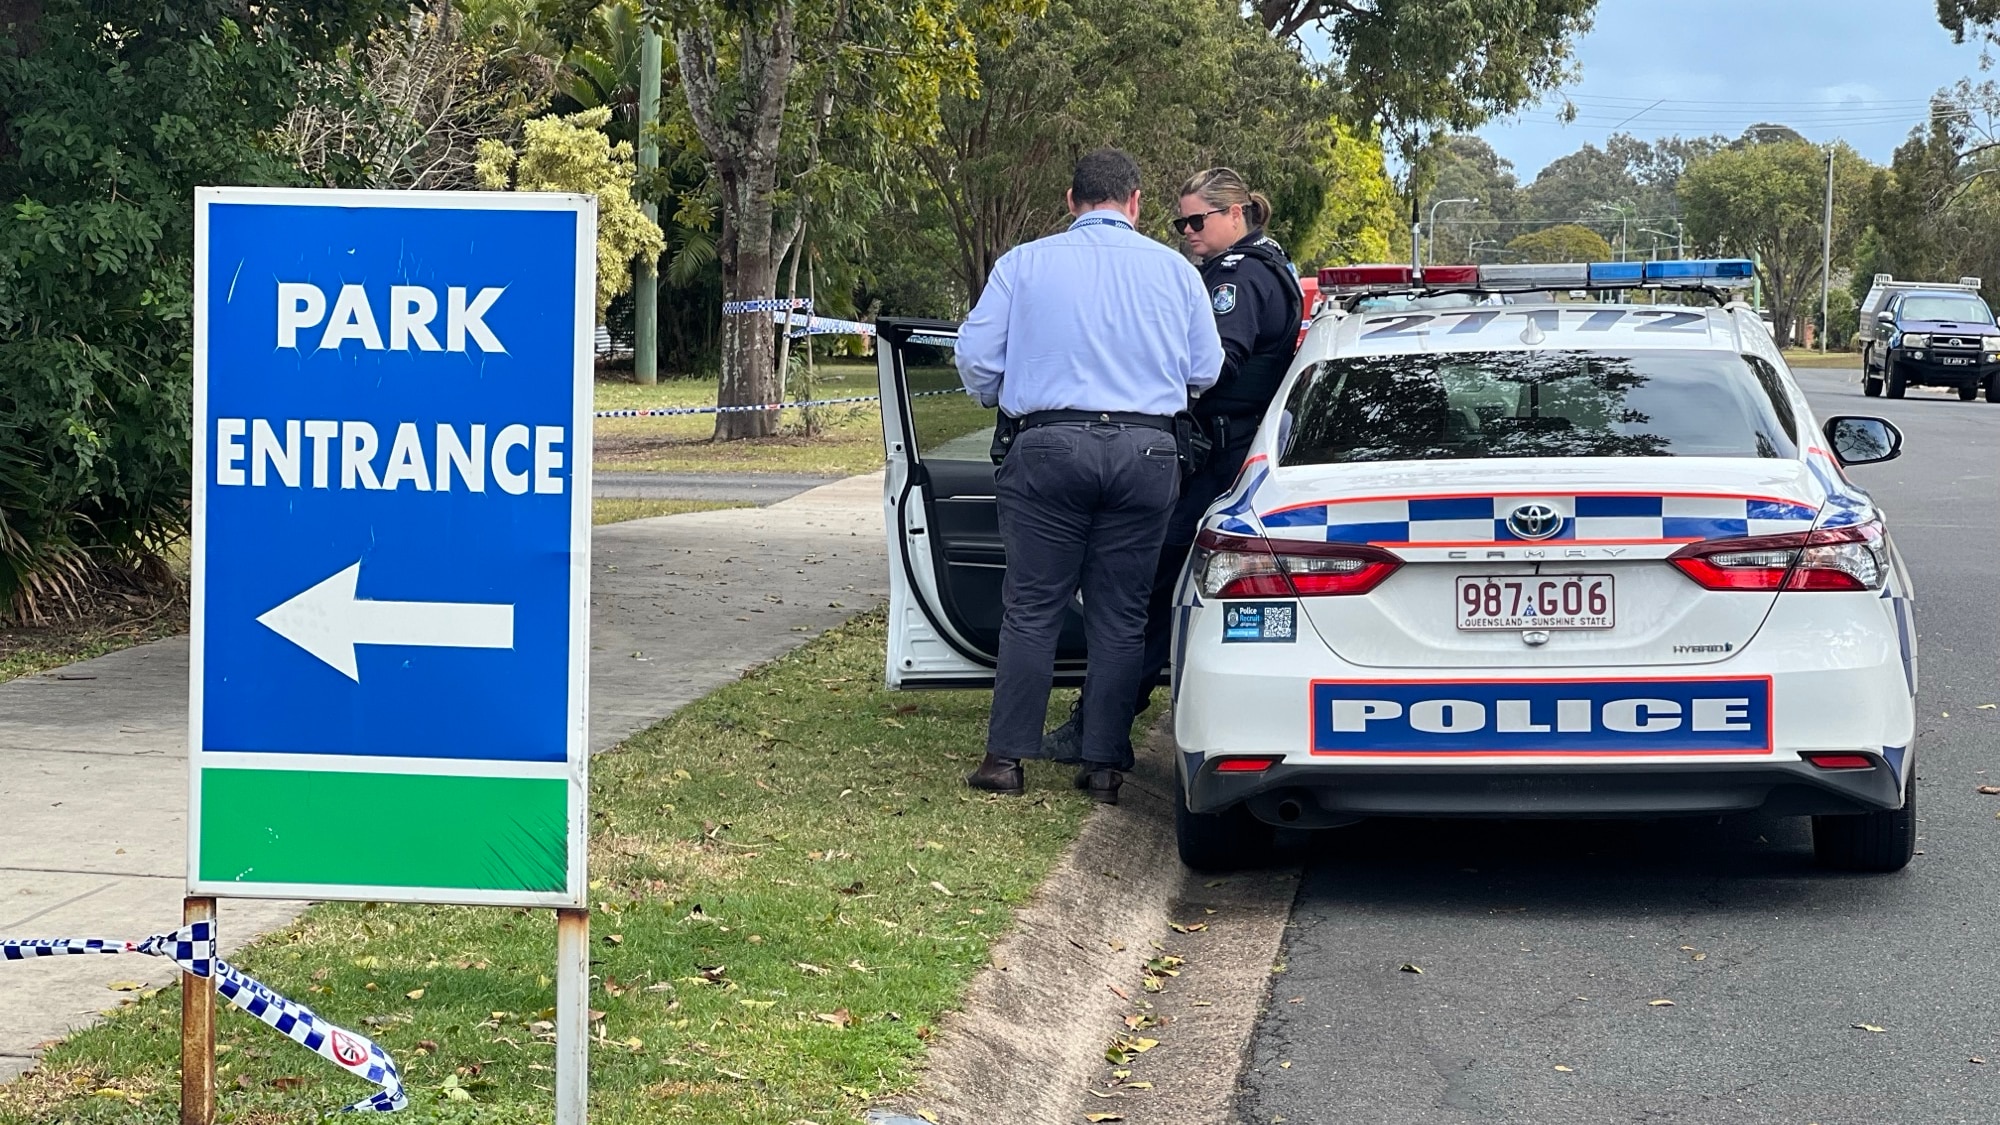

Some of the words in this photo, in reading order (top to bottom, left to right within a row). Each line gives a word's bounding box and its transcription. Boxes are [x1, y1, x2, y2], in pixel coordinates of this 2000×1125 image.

[276, 281, 508, 354] PARK
[216, 418, 564, 496] ENTRANCE
[1448, 549, 1626, 559] CAMRY
[1239, 606, 1257, 615] Police
[1464, 617, 1523, 627] QUEENSLAND
[1531, 617, 1576, 627] SUNSHINE
[1579, 616, 1607, 626] STATE
[1673, 645, 1724, 653] HYBRID
[1331, 698, 1751, 734] POLICE
